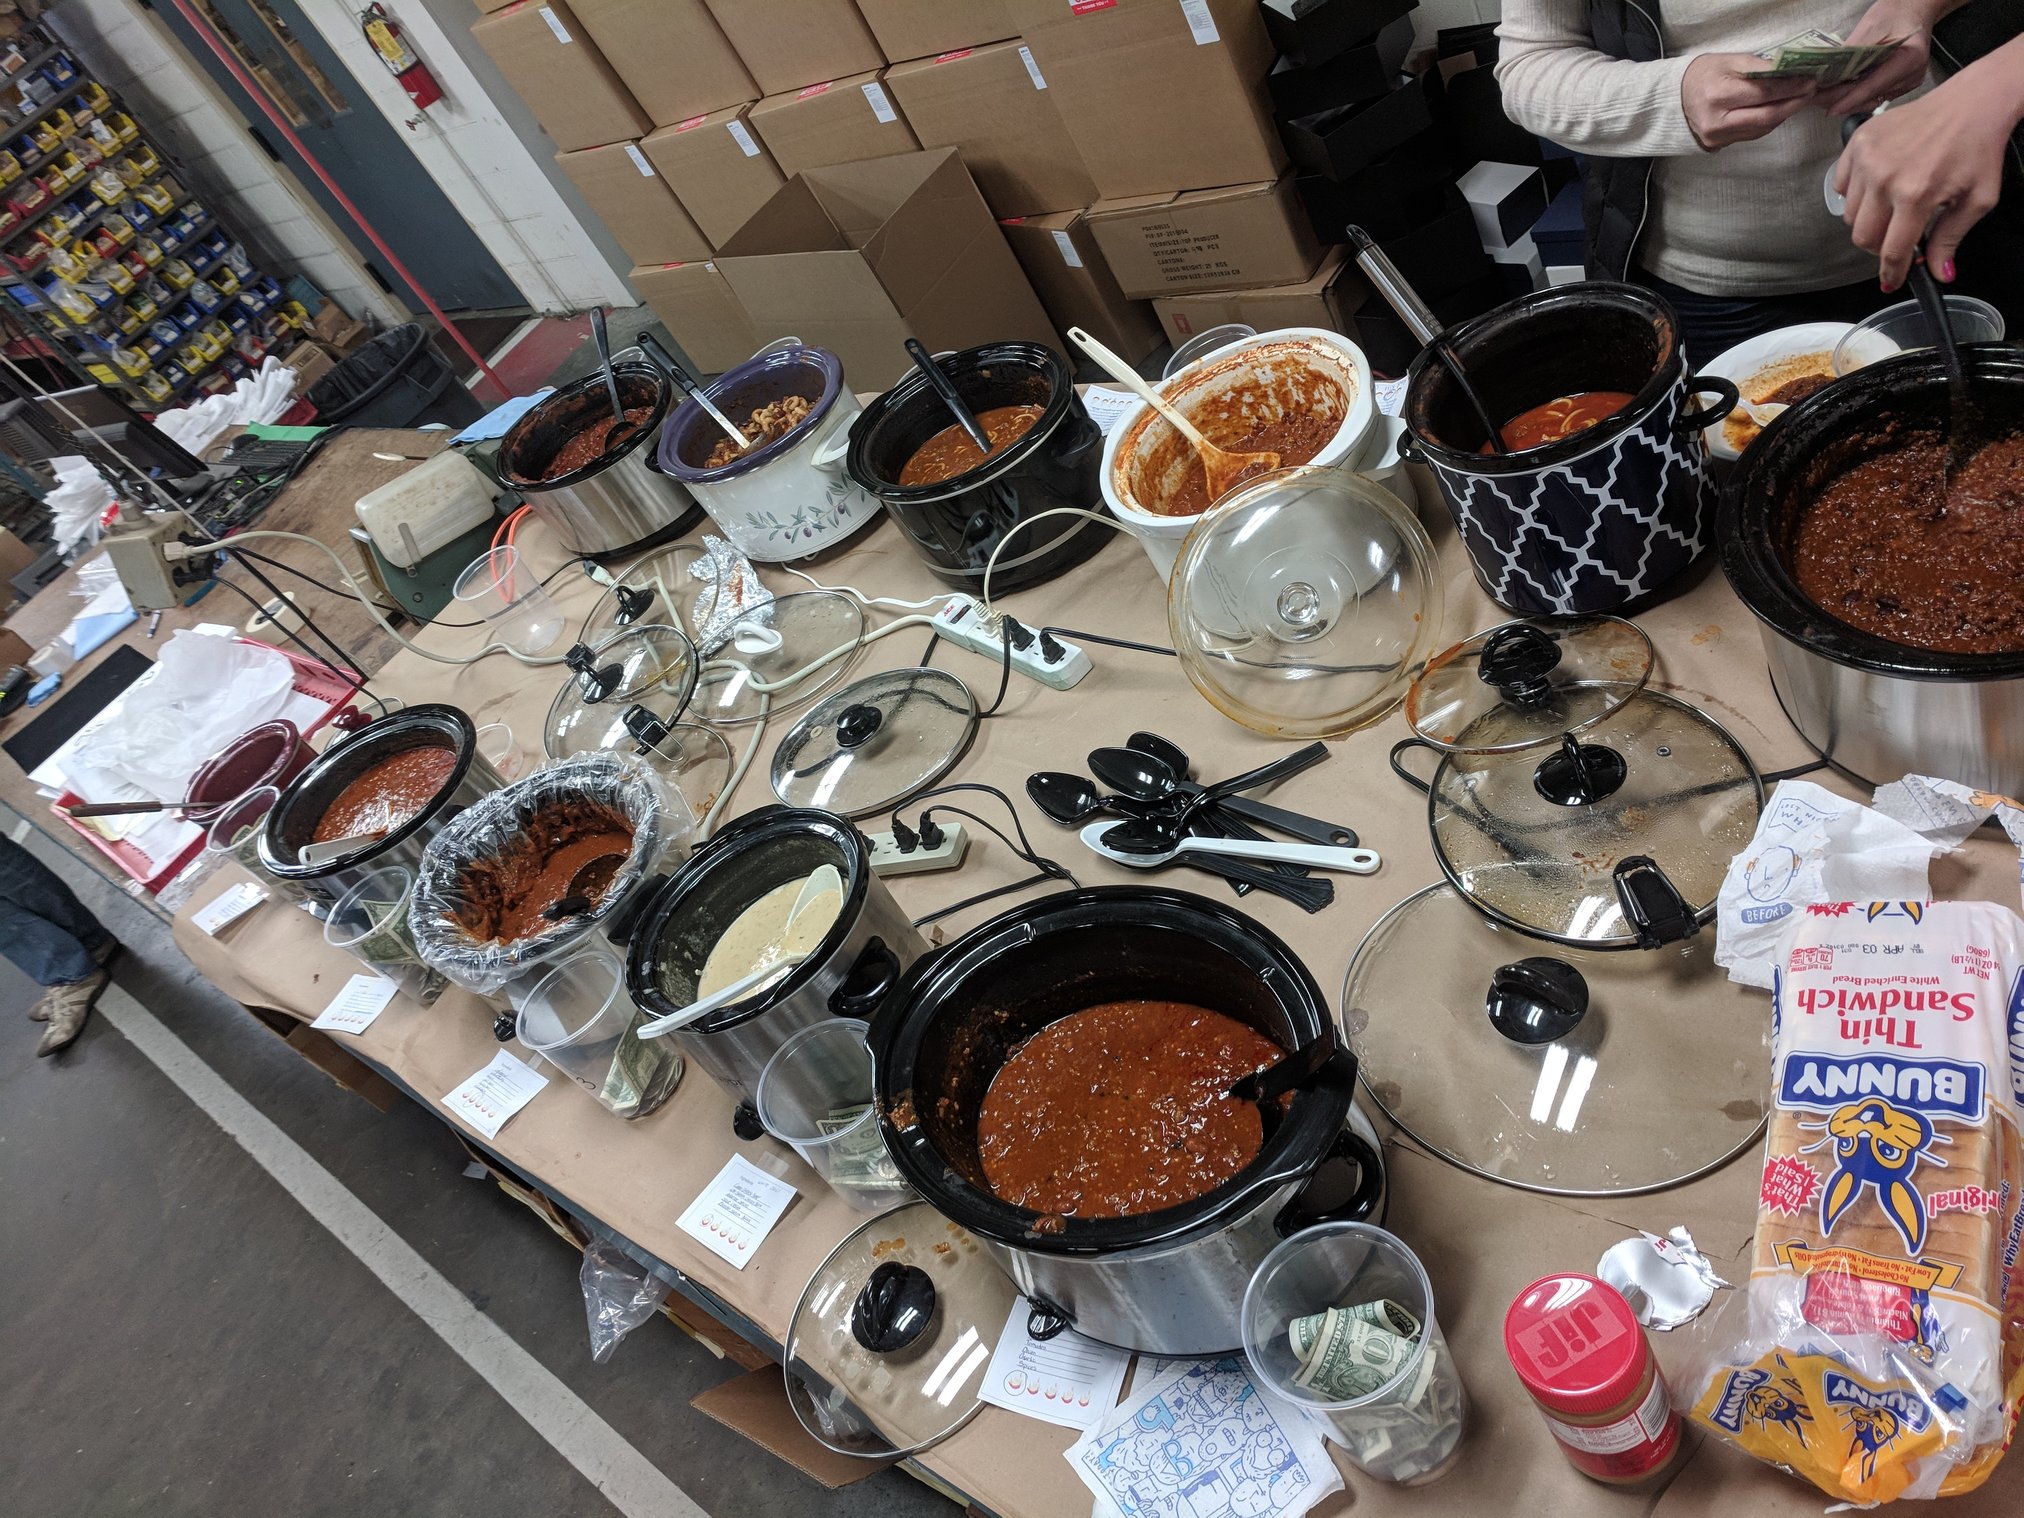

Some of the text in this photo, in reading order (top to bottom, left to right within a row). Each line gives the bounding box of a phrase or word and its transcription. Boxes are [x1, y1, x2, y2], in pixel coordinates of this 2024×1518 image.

[1746, 903, 1786, 923] BEFORE
[1862, 944, 1904, 954] APR 03
[1966, 943, 1990, 957] (680G)
[1820, 954, 1829, 962] 70
[1951, 953, 1965, 964] LB)
[1981, 960, 1993, 970] OZ
[1963, 965, 1990, 980] NET WT
[1832, 976, 1940, 985] White Enriched Bread
[1797, 988, 1975, 1021] Sandwich
[1840, 1018, 1923, 1049] Thin
[1793, 1062, 1966, 1105] BUNNY
[1774, 1163, 1804, 1183] Said
[1770, 1173, 1803, 1197] What
[1764, 1183, 1799, 1207] That's
[1795, 1252, 1807, 1261] Oils
[1848, 1253, 1857, 1261] No
[1849, 1263, 1857, 1272] No
[1874, 1260, 1890, 1270] Trans
[1890, 1262, 1899, 1271] No
[1862, 1268, 1899, 1281] Cholesterol
[1900, 1274, 1909, 1282] No
[1916, 1268, 1931, 1279] Low
[1323, 1331, 1342, 1367] UNITED
[1719, 1369, 1762, 1428] BUNNY
[1833, 1379, 1923, 1420] BUNNY
